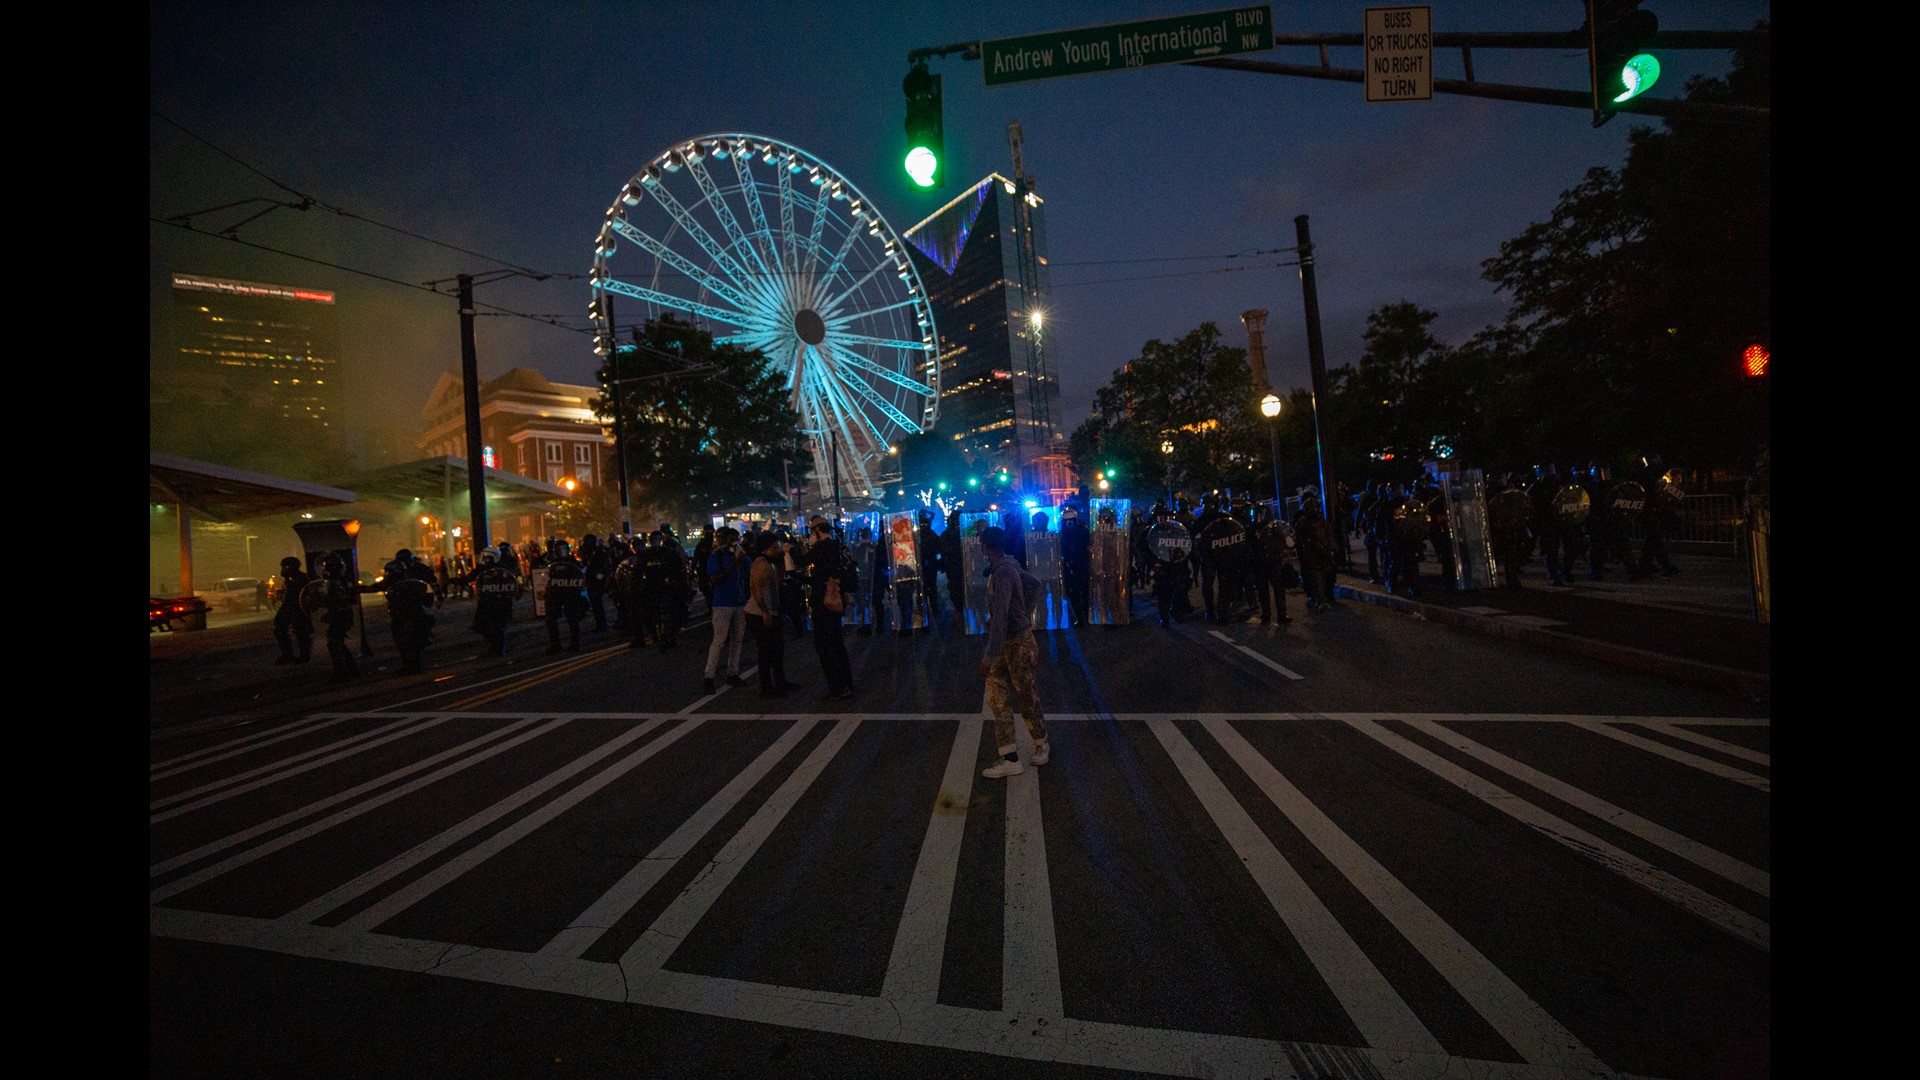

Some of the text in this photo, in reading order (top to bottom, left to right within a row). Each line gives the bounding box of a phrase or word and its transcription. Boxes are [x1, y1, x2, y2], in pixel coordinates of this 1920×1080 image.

[1235, 10, 1264, 28] BLVD
[1384, 12, 1412, 28] BUSES
[994, 21, 1229, 74] Andrew Young International
[1241, 33, 1260, 50] NW
[1369, 33, 1428, 51] OR TRUCKS
[1125, 54, 1145, 67] 140
[1374, 56, 1424, 73] NO RIGHT
[1382, 79, 1416, 96] TURN
[1614, 499, 1645, 510] POLICE
[1158, 538, 1192, 548] POLICE
[1211, 532, 1246, 549] POLICE
[482, 583, 515, 592] POLICE
[551, 578, 585, 588] POLICE
